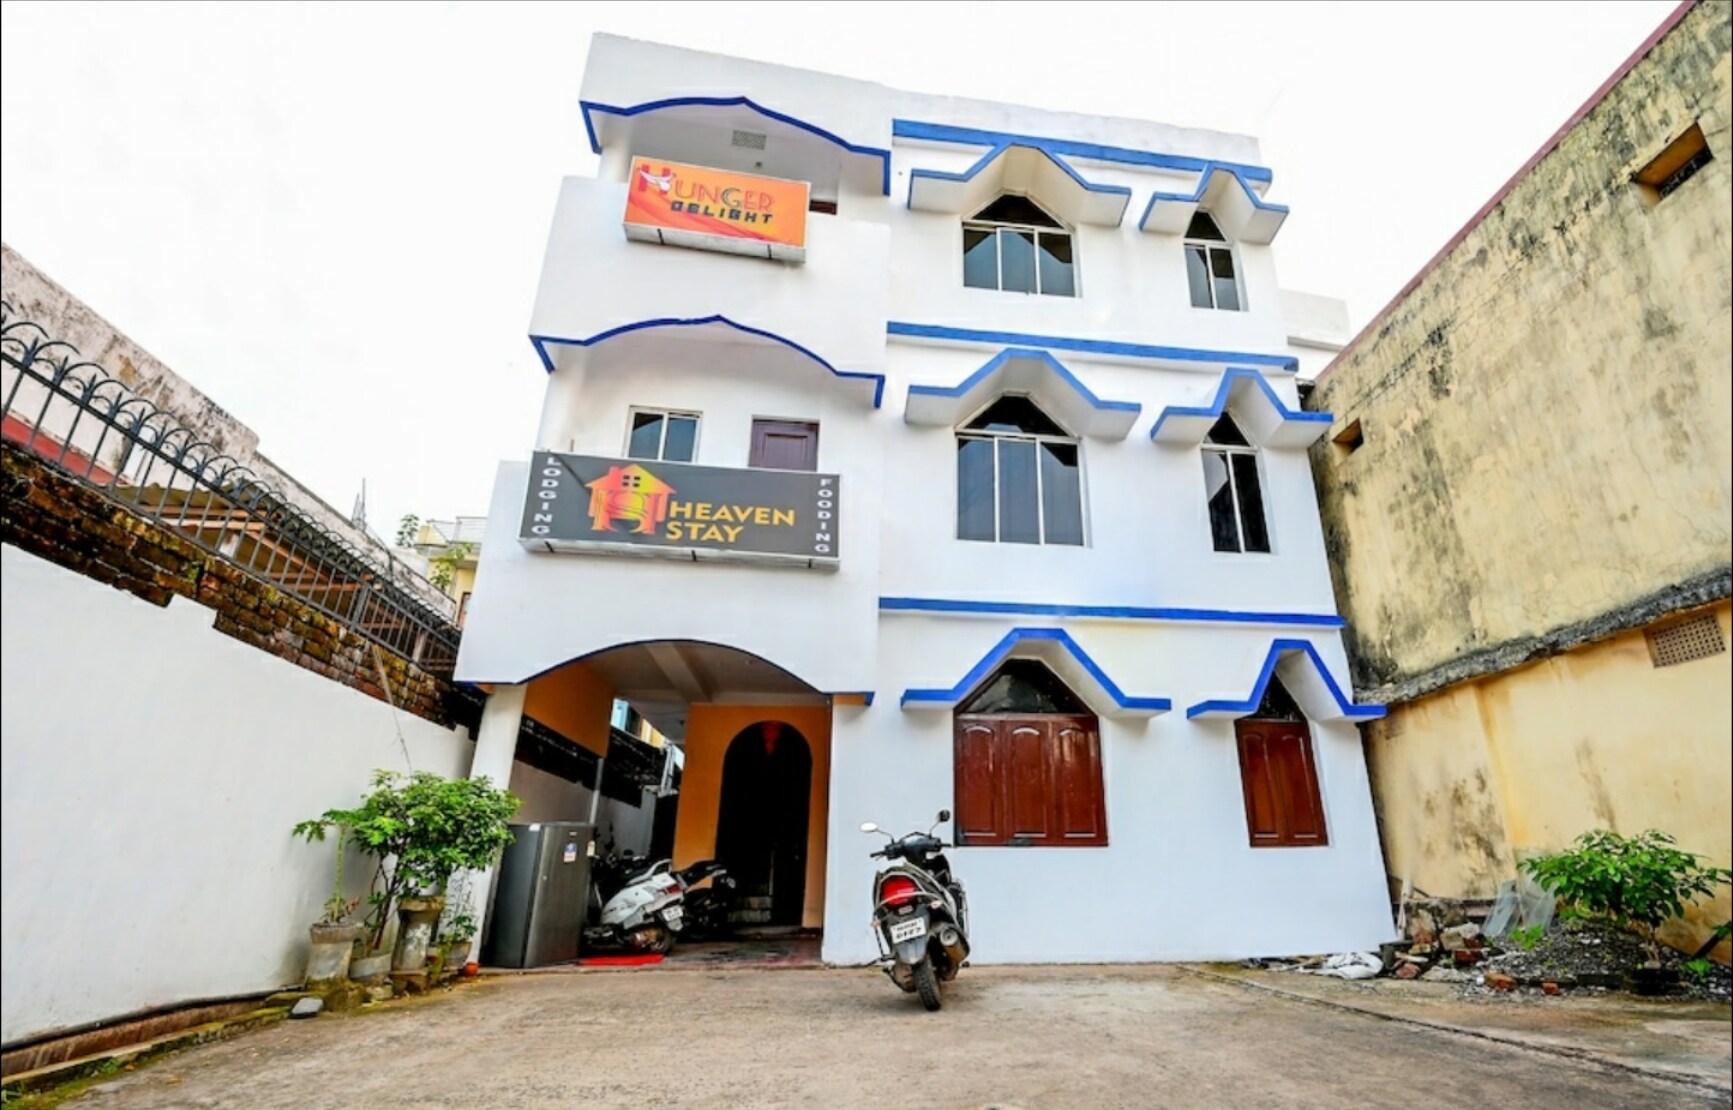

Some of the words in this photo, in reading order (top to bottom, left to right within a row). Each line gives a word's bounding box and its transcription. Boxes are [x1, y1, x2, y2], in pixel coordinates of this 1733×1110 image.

[637, 164, 775, 212] HUNGER
[670, 200, 773, 225] DELIGHT
[531, 456, 562, 534] LODGING
[669, 500, 795, 527] HEAVEN
[666, 520, 745, 543] STAY
[814, 478, 834, 553] FOODING
